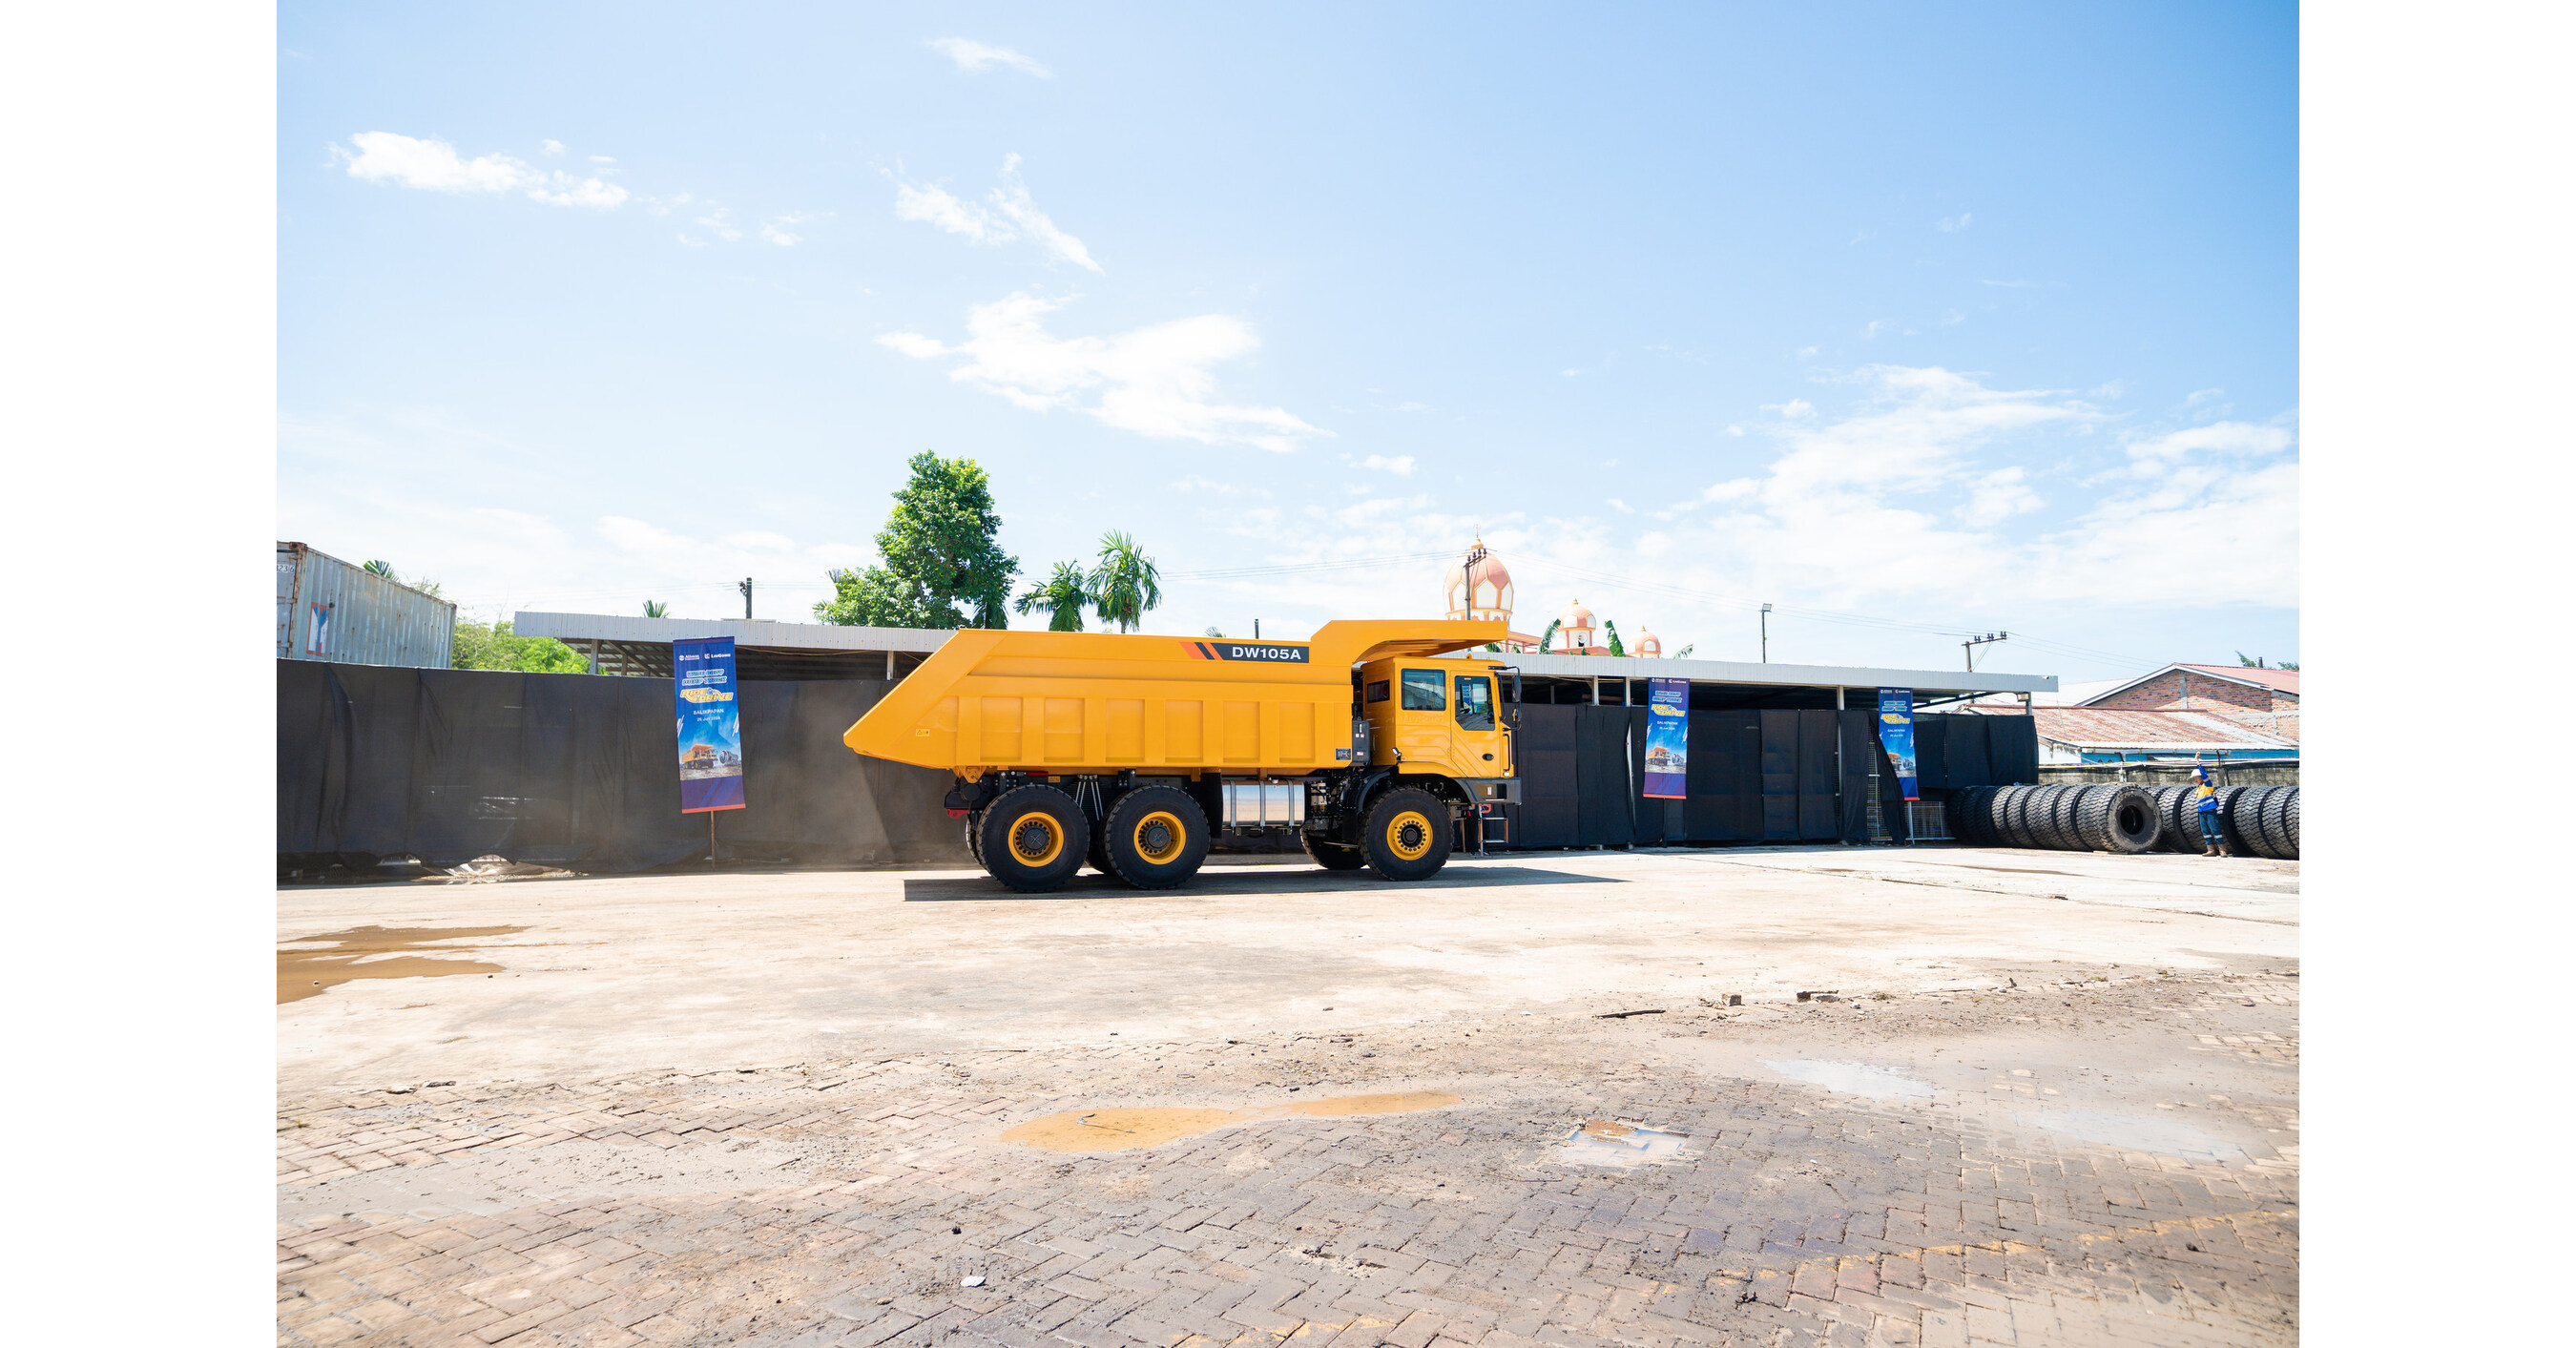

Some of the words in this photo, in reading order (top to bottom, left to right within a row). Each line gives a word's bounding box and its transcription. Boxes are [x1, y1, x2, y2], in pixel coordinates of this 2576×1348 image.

[1232, 646, 1301, 660] DW105A
[680, 688, 707, 699] RIDE
[698, 690, 734, 703] DRIVE
